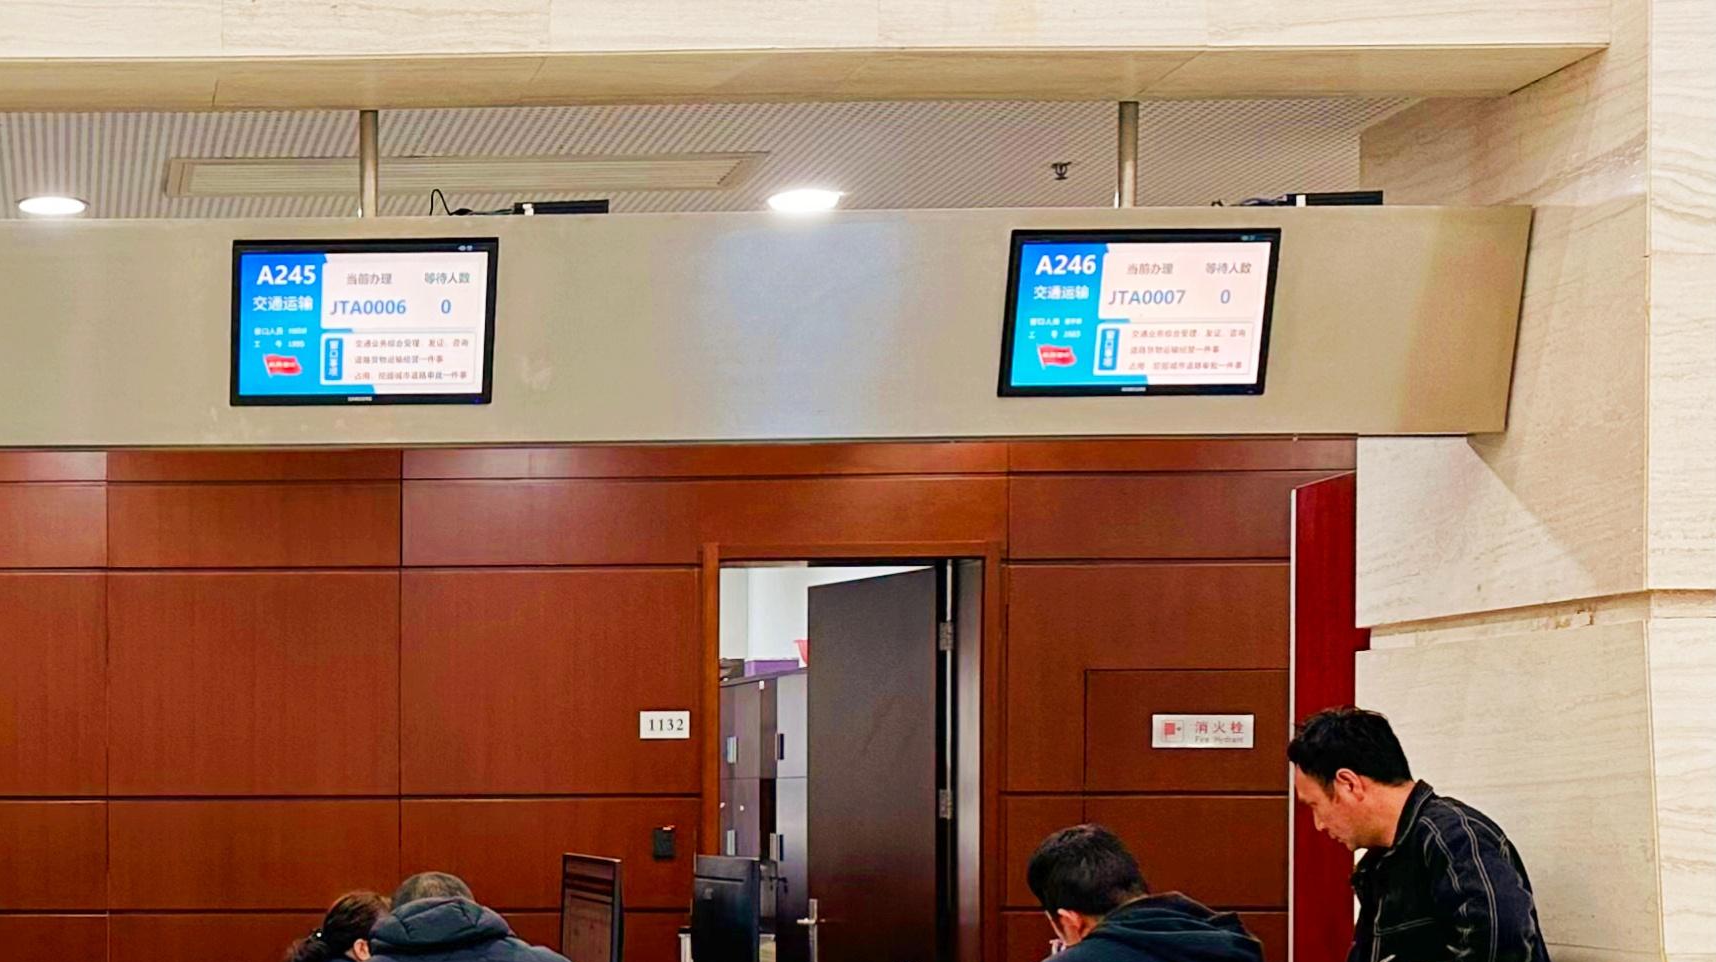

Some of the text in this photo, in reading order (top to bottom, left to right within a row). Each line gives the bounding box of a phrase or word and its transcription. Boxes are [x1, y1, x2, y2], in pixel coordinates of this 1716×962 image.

[1035, 255, 1097, 275] A246
[1127, 262, 1174, 274] 当前办理
[1206, 262, 1252, 274] 等待人数
[256, 265, 316, 285] A245
[347, 272, 392, 285] 当前办理
[424, 272, 470, 284] 等待人数
[1033, 285, 1090, 300] 交通运输
[1108, 289, 1186, 305] JTA0007
[1220, 289, 1231, 304] 0
[252, 296, 314, 312] 交通运输
[330, 299, 407, 315] JTA0006
[440, 299, 452, 315] 0
[648, 718, 684, 732] 1132
[1195, 720, 1244, 734] 消火栓
